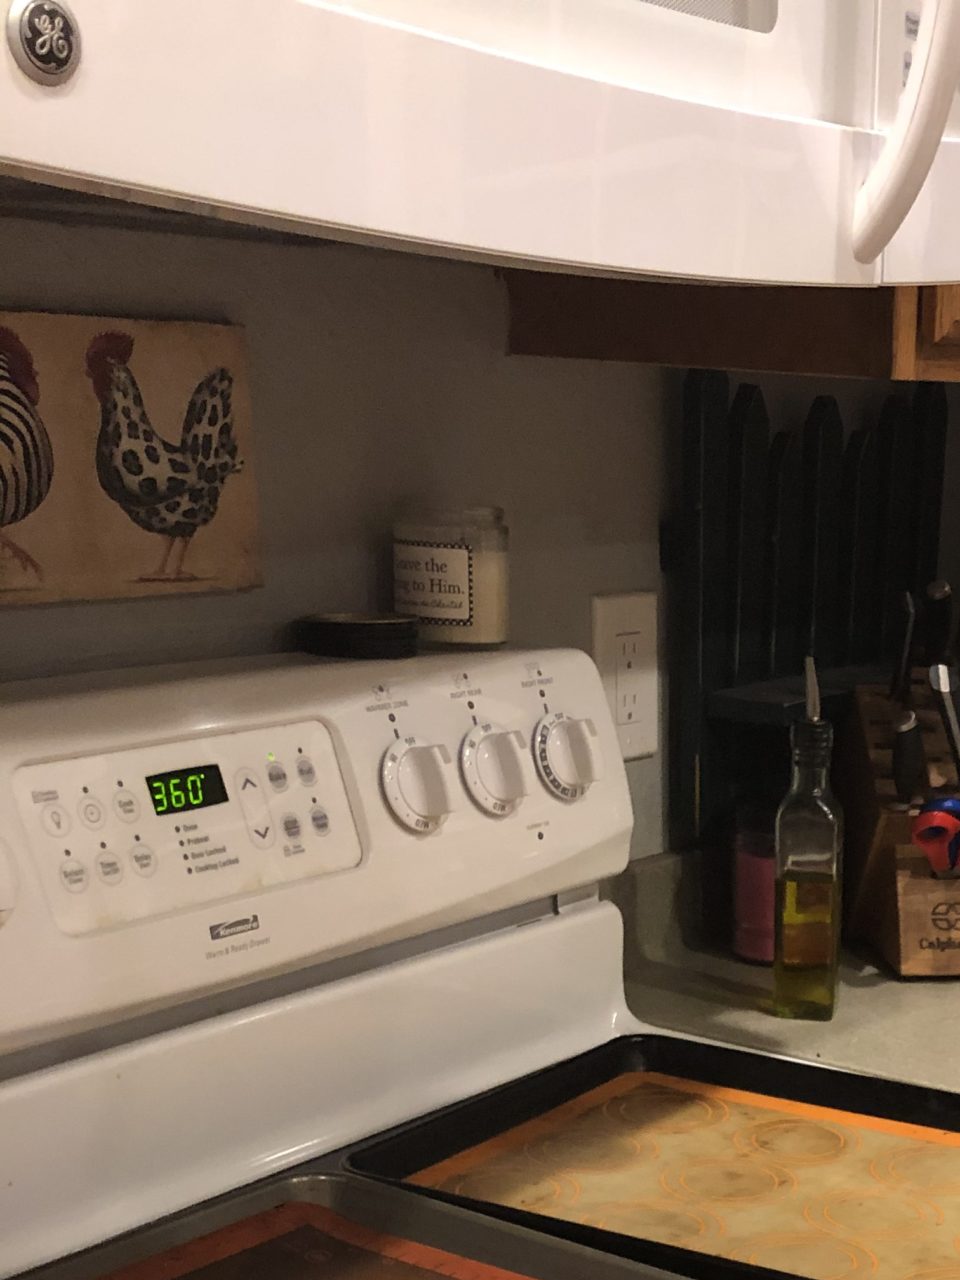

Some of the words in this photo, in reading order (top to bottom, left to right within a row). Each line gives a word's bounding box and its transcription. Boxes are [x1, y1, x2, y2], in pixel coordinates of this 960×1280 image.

[425, 557, 448, 574] the
[412, 580, 426, 592] to
[429, 578, 465, 595] Him.
[219, 921, 258, 937] Kenmore
